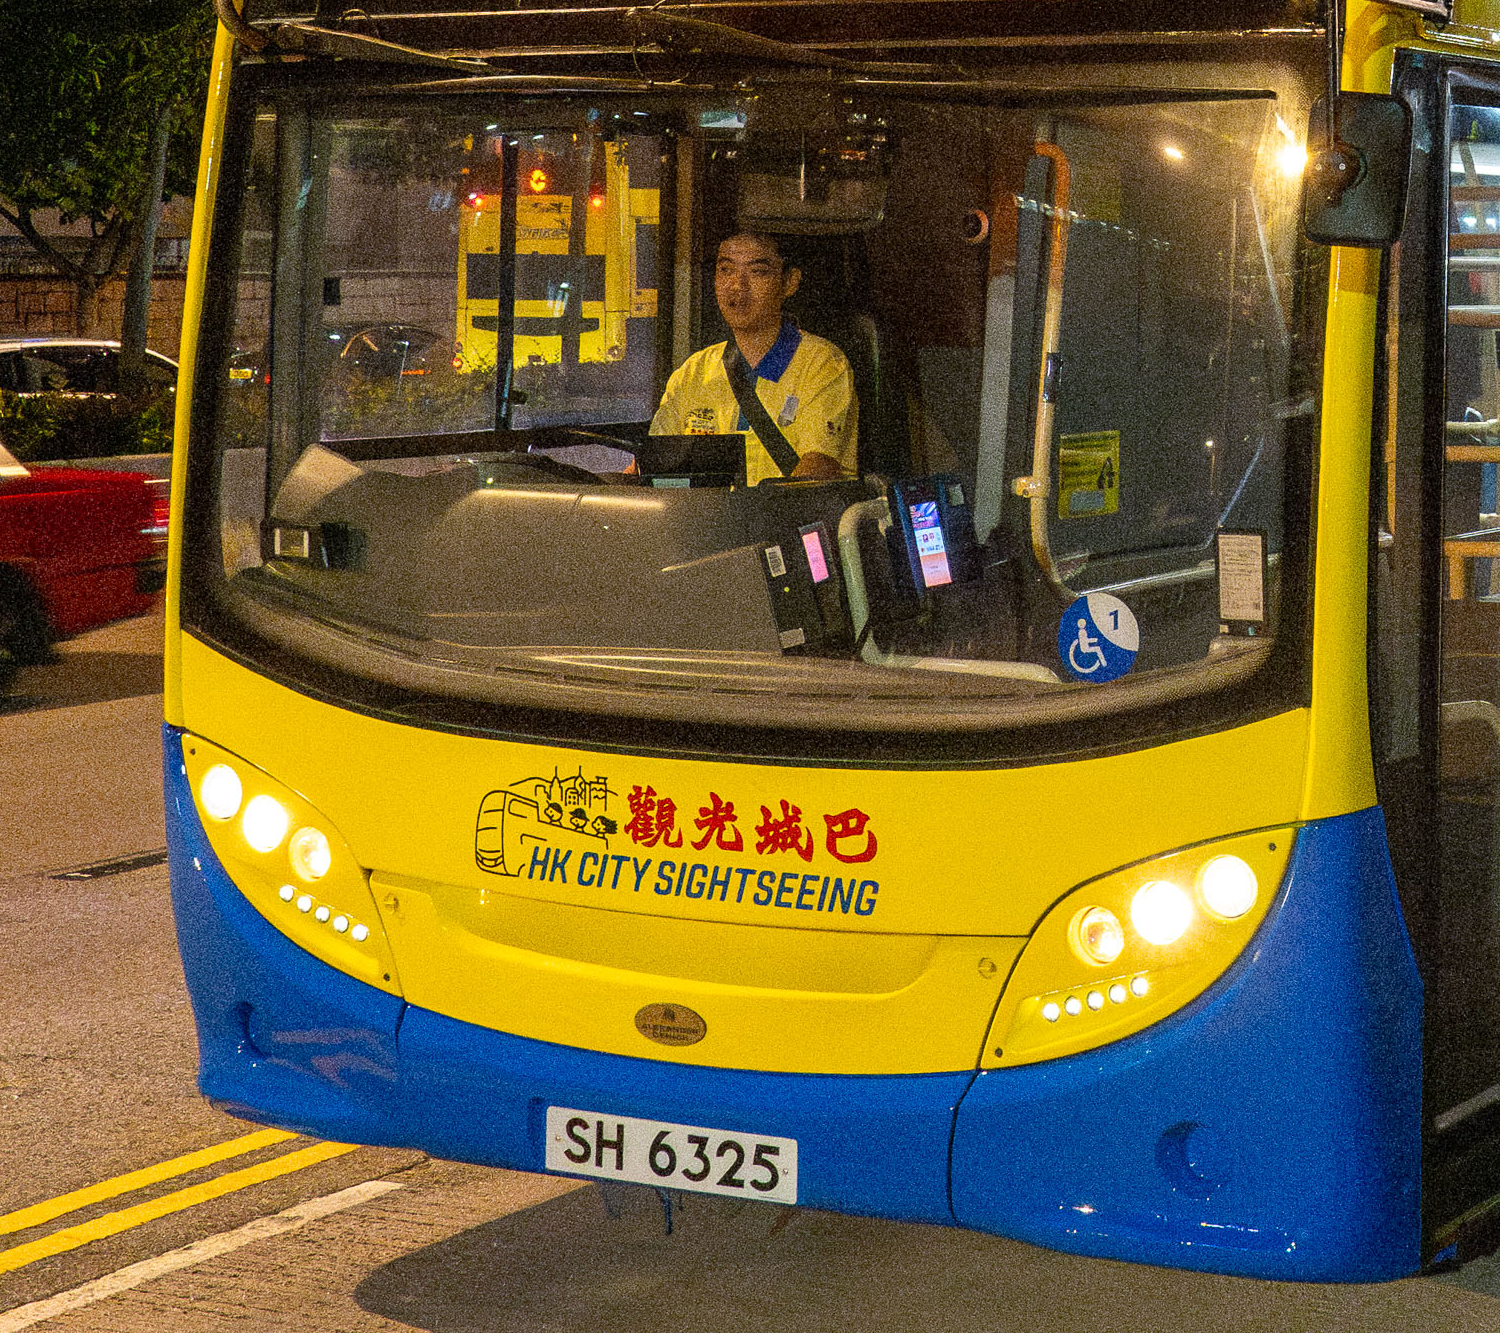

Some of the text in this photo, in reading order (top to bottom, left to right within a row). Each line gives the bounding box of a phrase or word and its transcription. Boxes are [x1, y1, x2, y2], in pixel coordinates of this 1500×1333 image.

[1108, 608, 1120, 632] 1
[623, 784, 879, 865] 觀光城巴
[527, 846, 881, 917] HK CITY SIGHTSEEING
[563, 1116, 782, 1194] SH 6325
